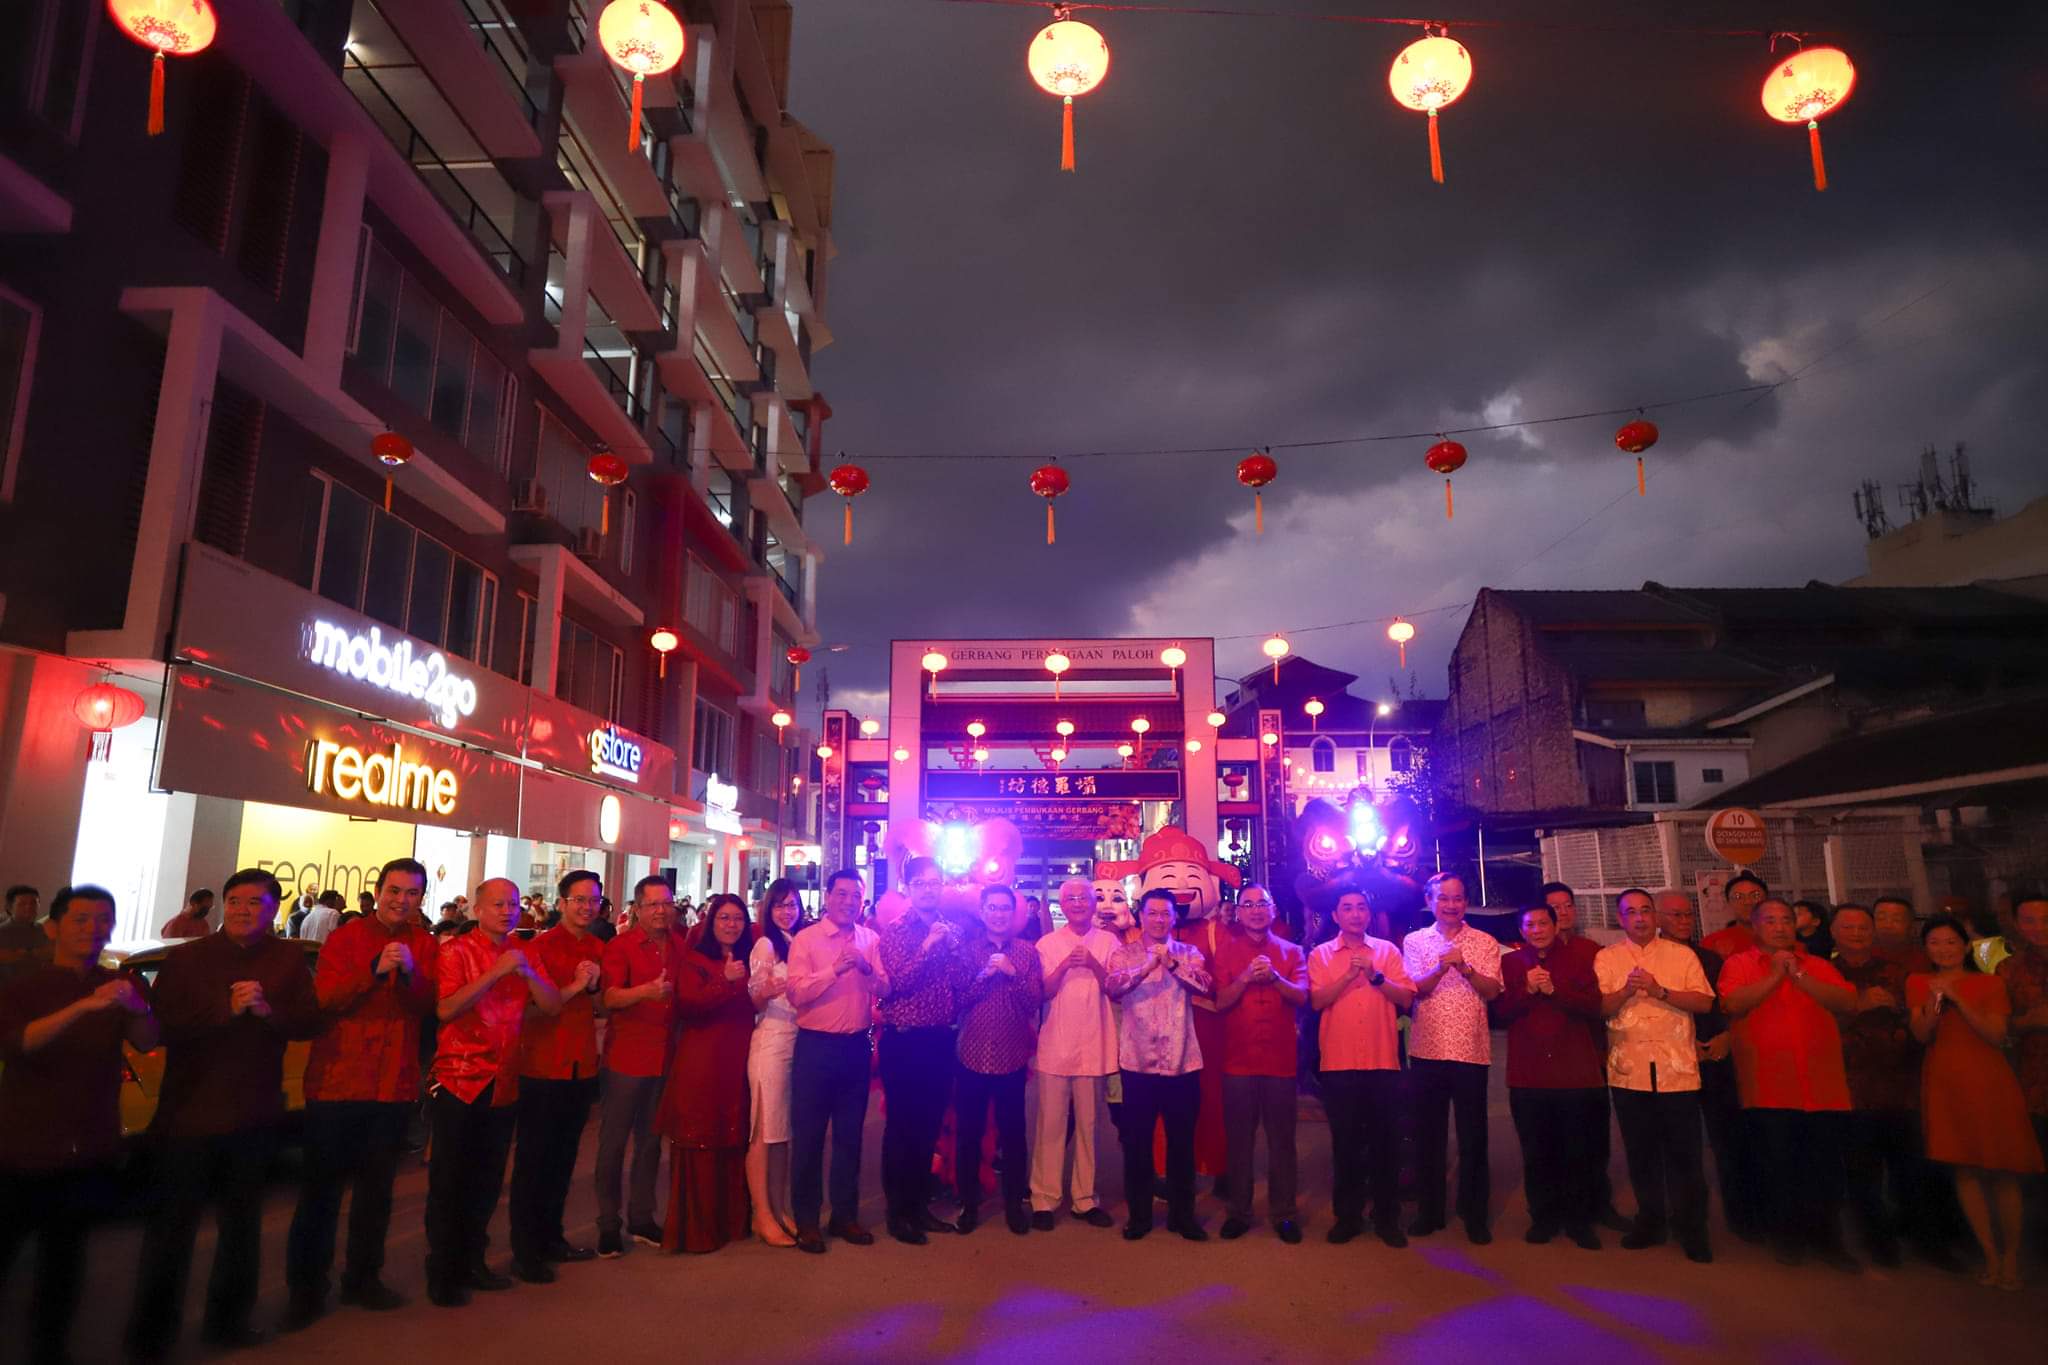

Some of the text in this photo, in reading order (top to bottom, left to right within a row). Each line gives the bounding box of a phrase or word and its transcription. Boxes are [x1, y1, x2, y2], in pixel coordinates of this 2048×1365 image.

[311, 620, 476, 729] mobile2go
[952, 650, 1012, 660] GERBANG
[1113, 650, 1154, 659] PALOH
[591, 730, 641, 775] gstore
[313, 738, 457, 815] realme
[1731, 814, 1745, 825] 10
